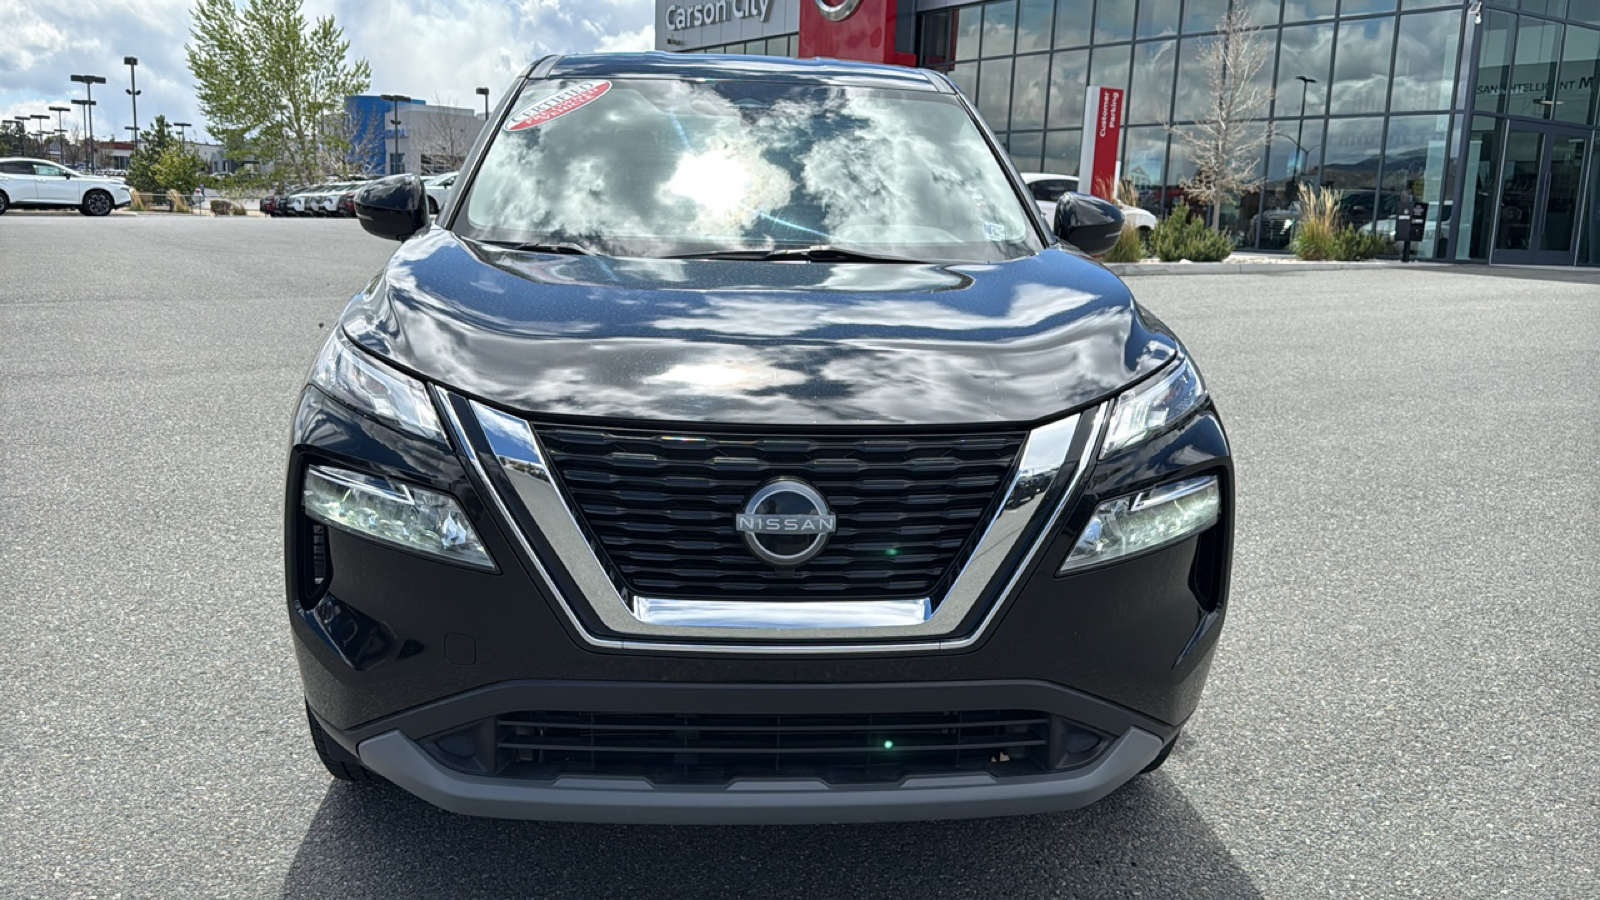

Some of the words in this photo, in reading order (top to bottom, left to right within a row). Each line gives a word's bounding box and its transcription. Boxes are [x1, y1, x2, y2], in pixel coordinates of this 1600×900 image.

[665, 0, 727, 31] Carson
[732, 0, 769, 22] City
[512, 82, 594, 122] CERTIFIED
[1100, 90, 1110, 138] Customer
[1109, 91, 1120, 129] Parking
[739, 517, 834, 531] NISSAN
